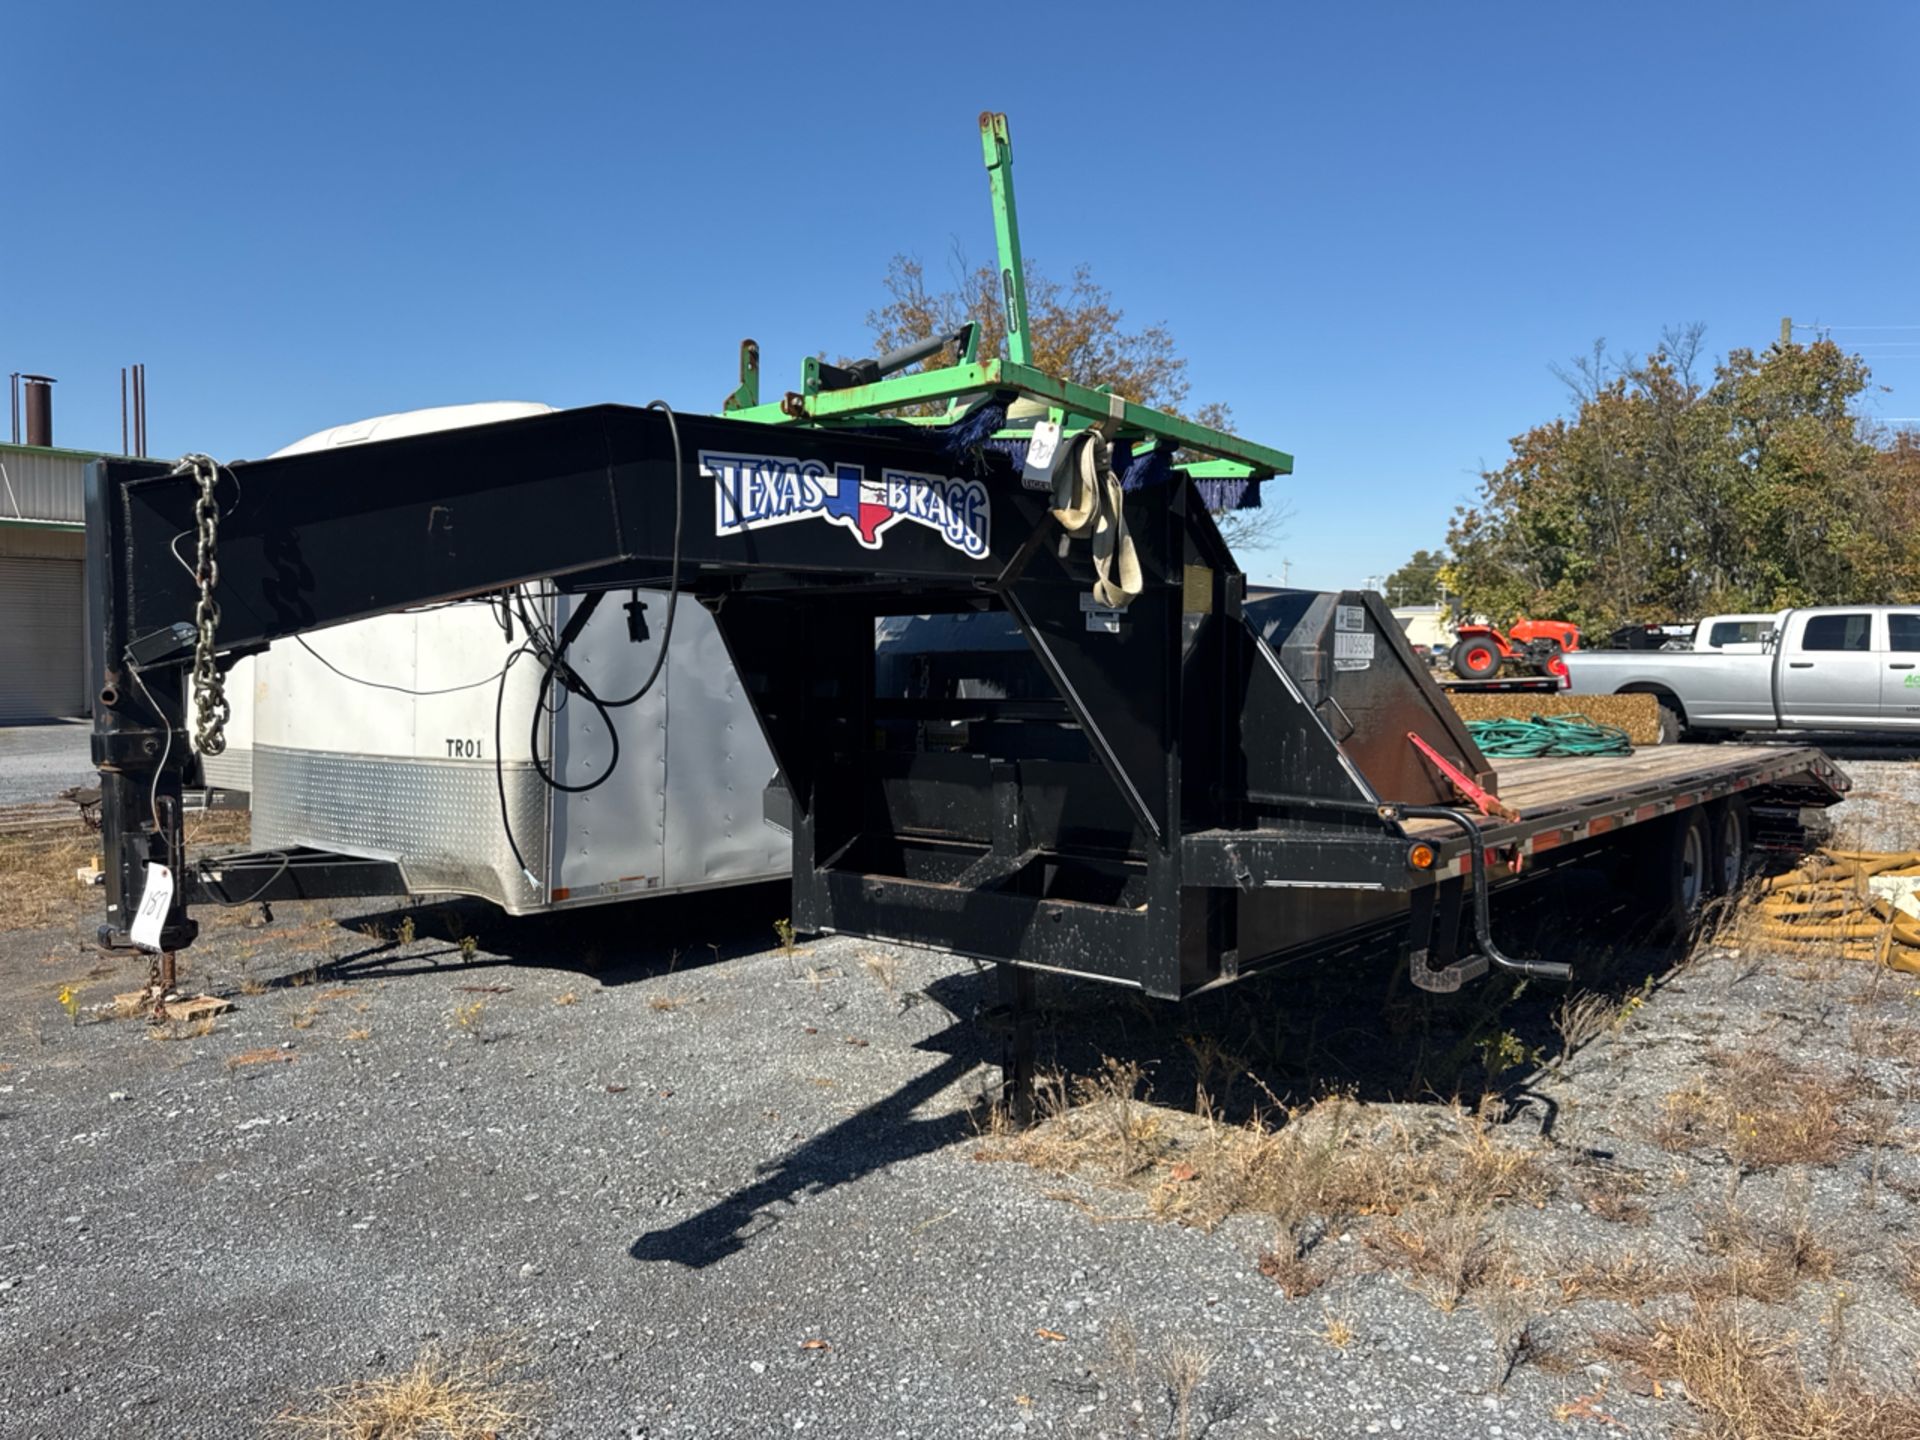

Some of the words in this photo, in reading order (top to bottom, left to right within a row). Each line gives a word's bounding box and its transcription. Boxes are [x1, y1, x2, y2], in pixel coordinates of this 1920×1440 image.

[702, 455, 825, 527] TEXAS
[886, 473, 986, 556] BRAGG
[445, 738, 482, 758] TR01
